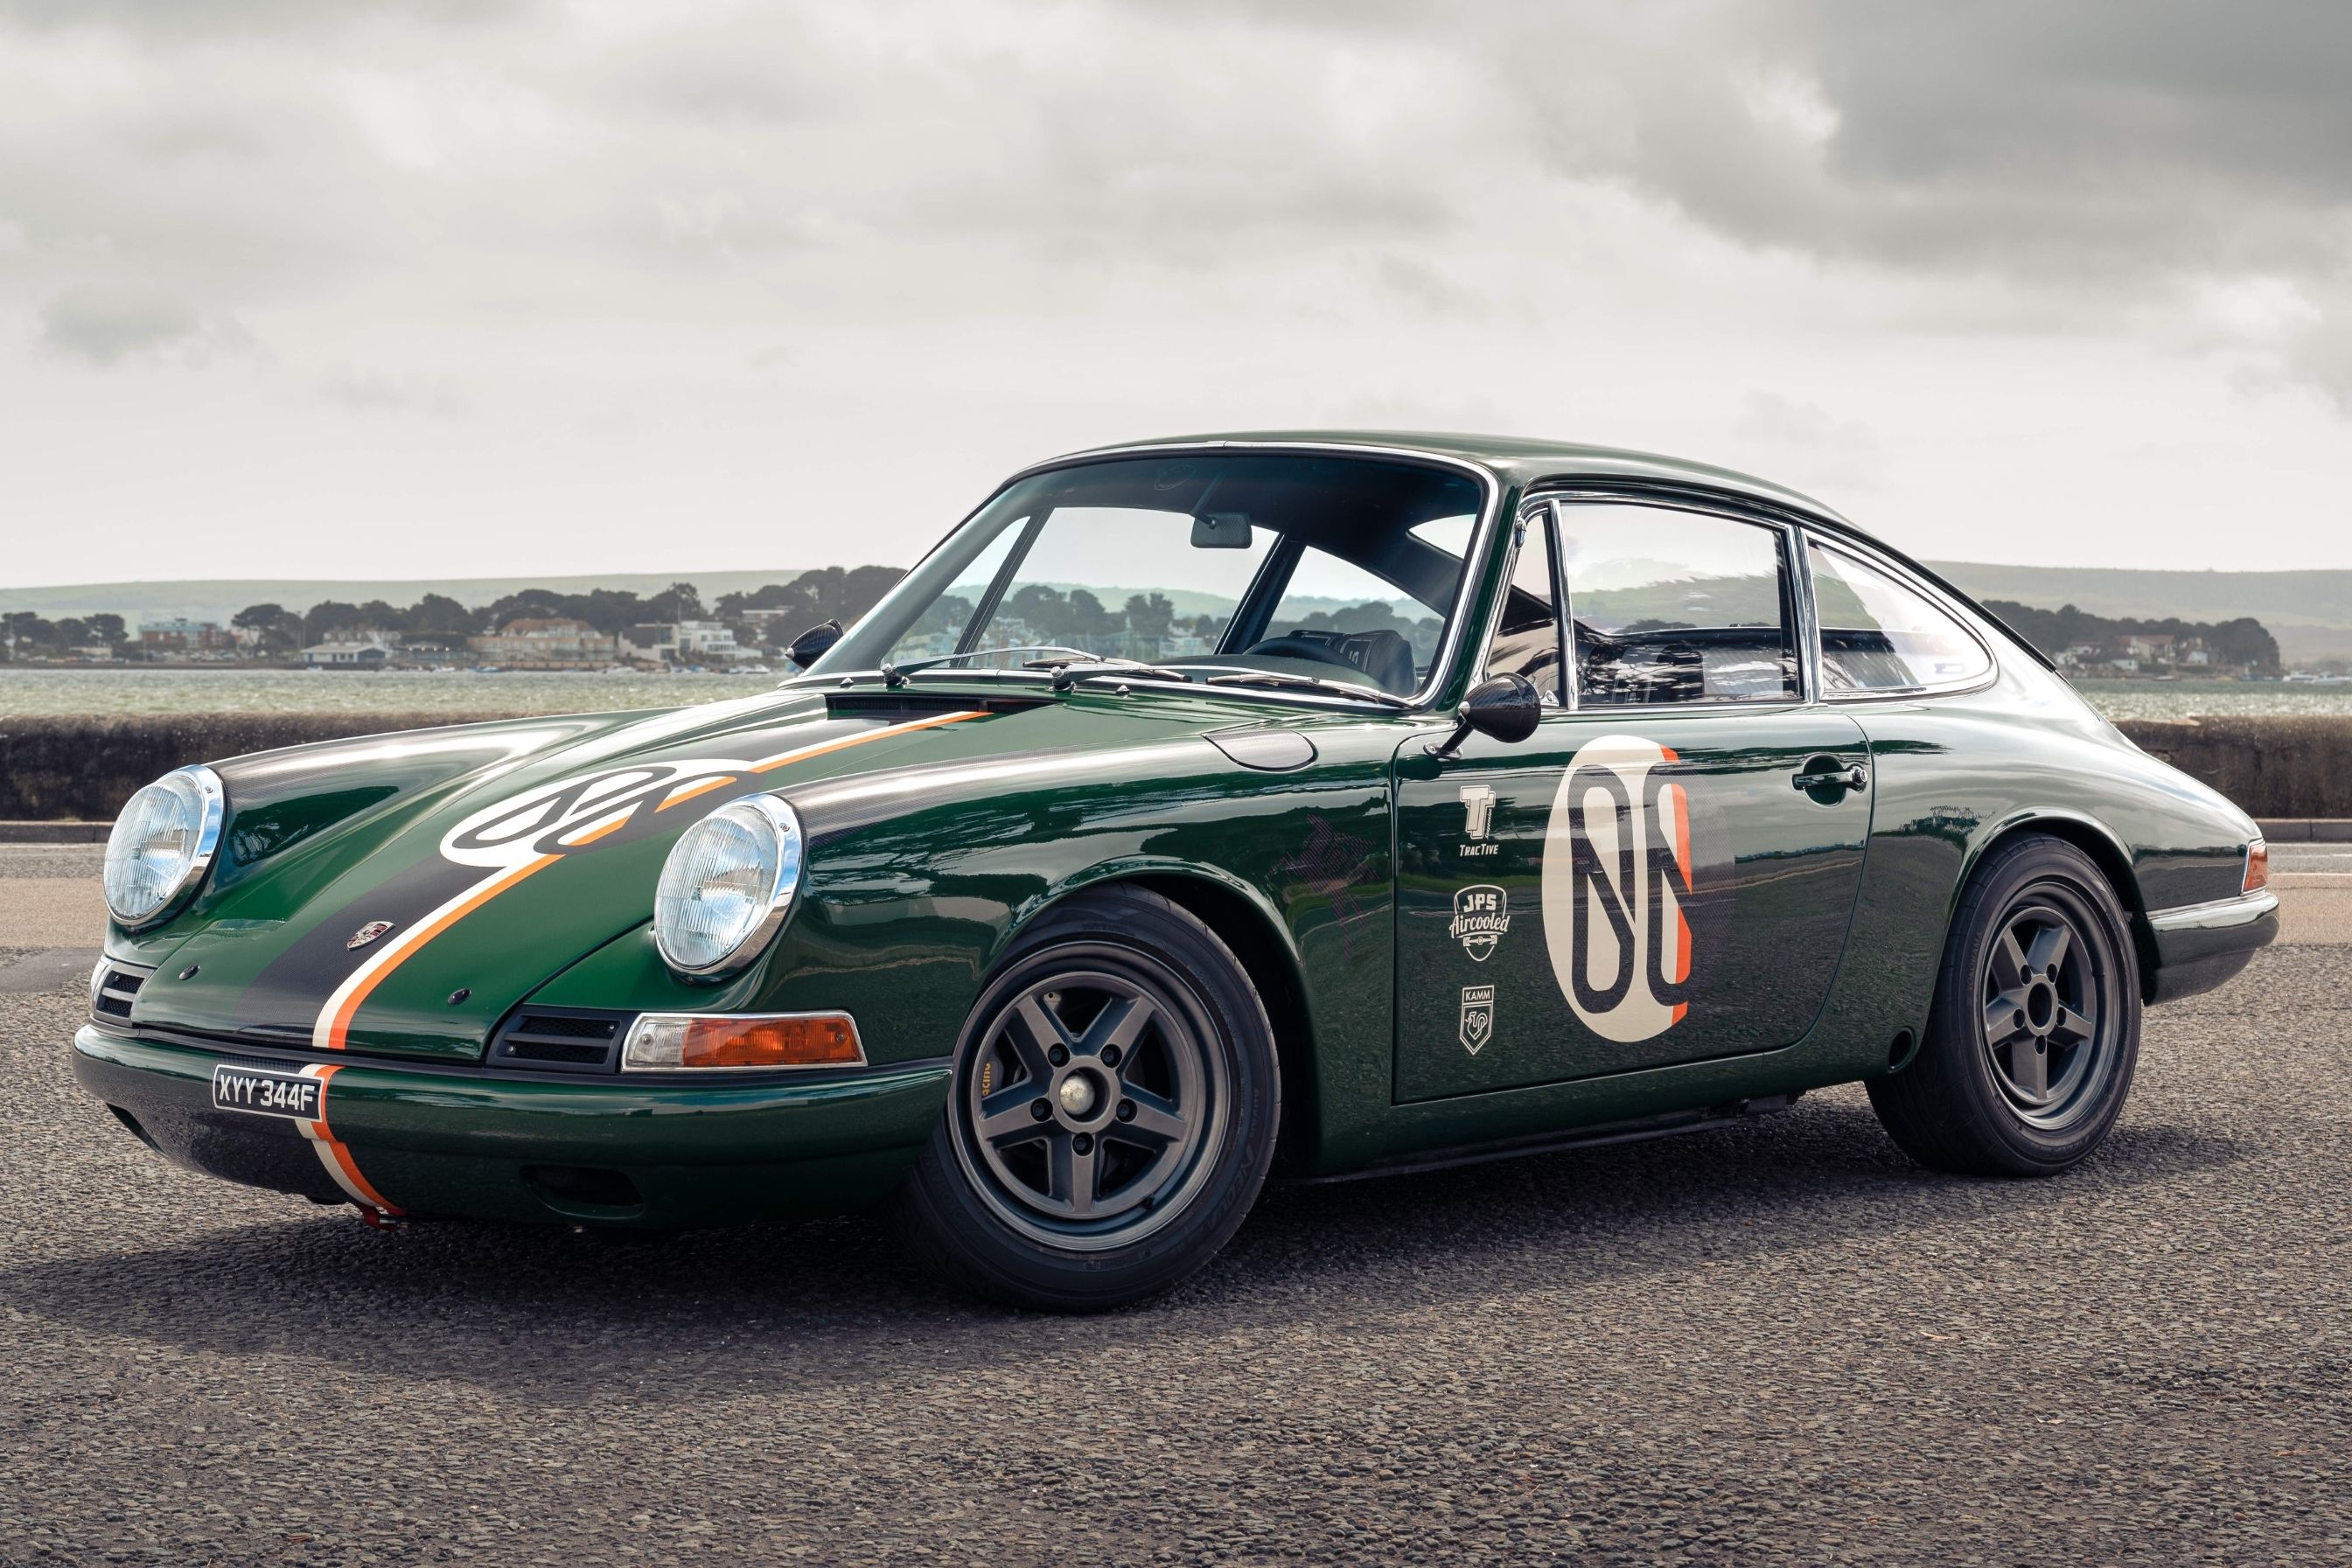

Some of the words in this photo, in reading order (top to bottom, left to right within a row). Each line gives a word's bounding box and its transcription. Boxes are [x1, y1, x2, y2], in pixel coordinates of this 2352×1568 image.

[1463, 894, 1497, 912] JPS
[1448, 912, 1511, 938] Aircooled
[1465, 989, 1490, 1000] KAMM
[219, 1074, 257, 1105] XYY
[260, 1079, 316, 1112] 344F
